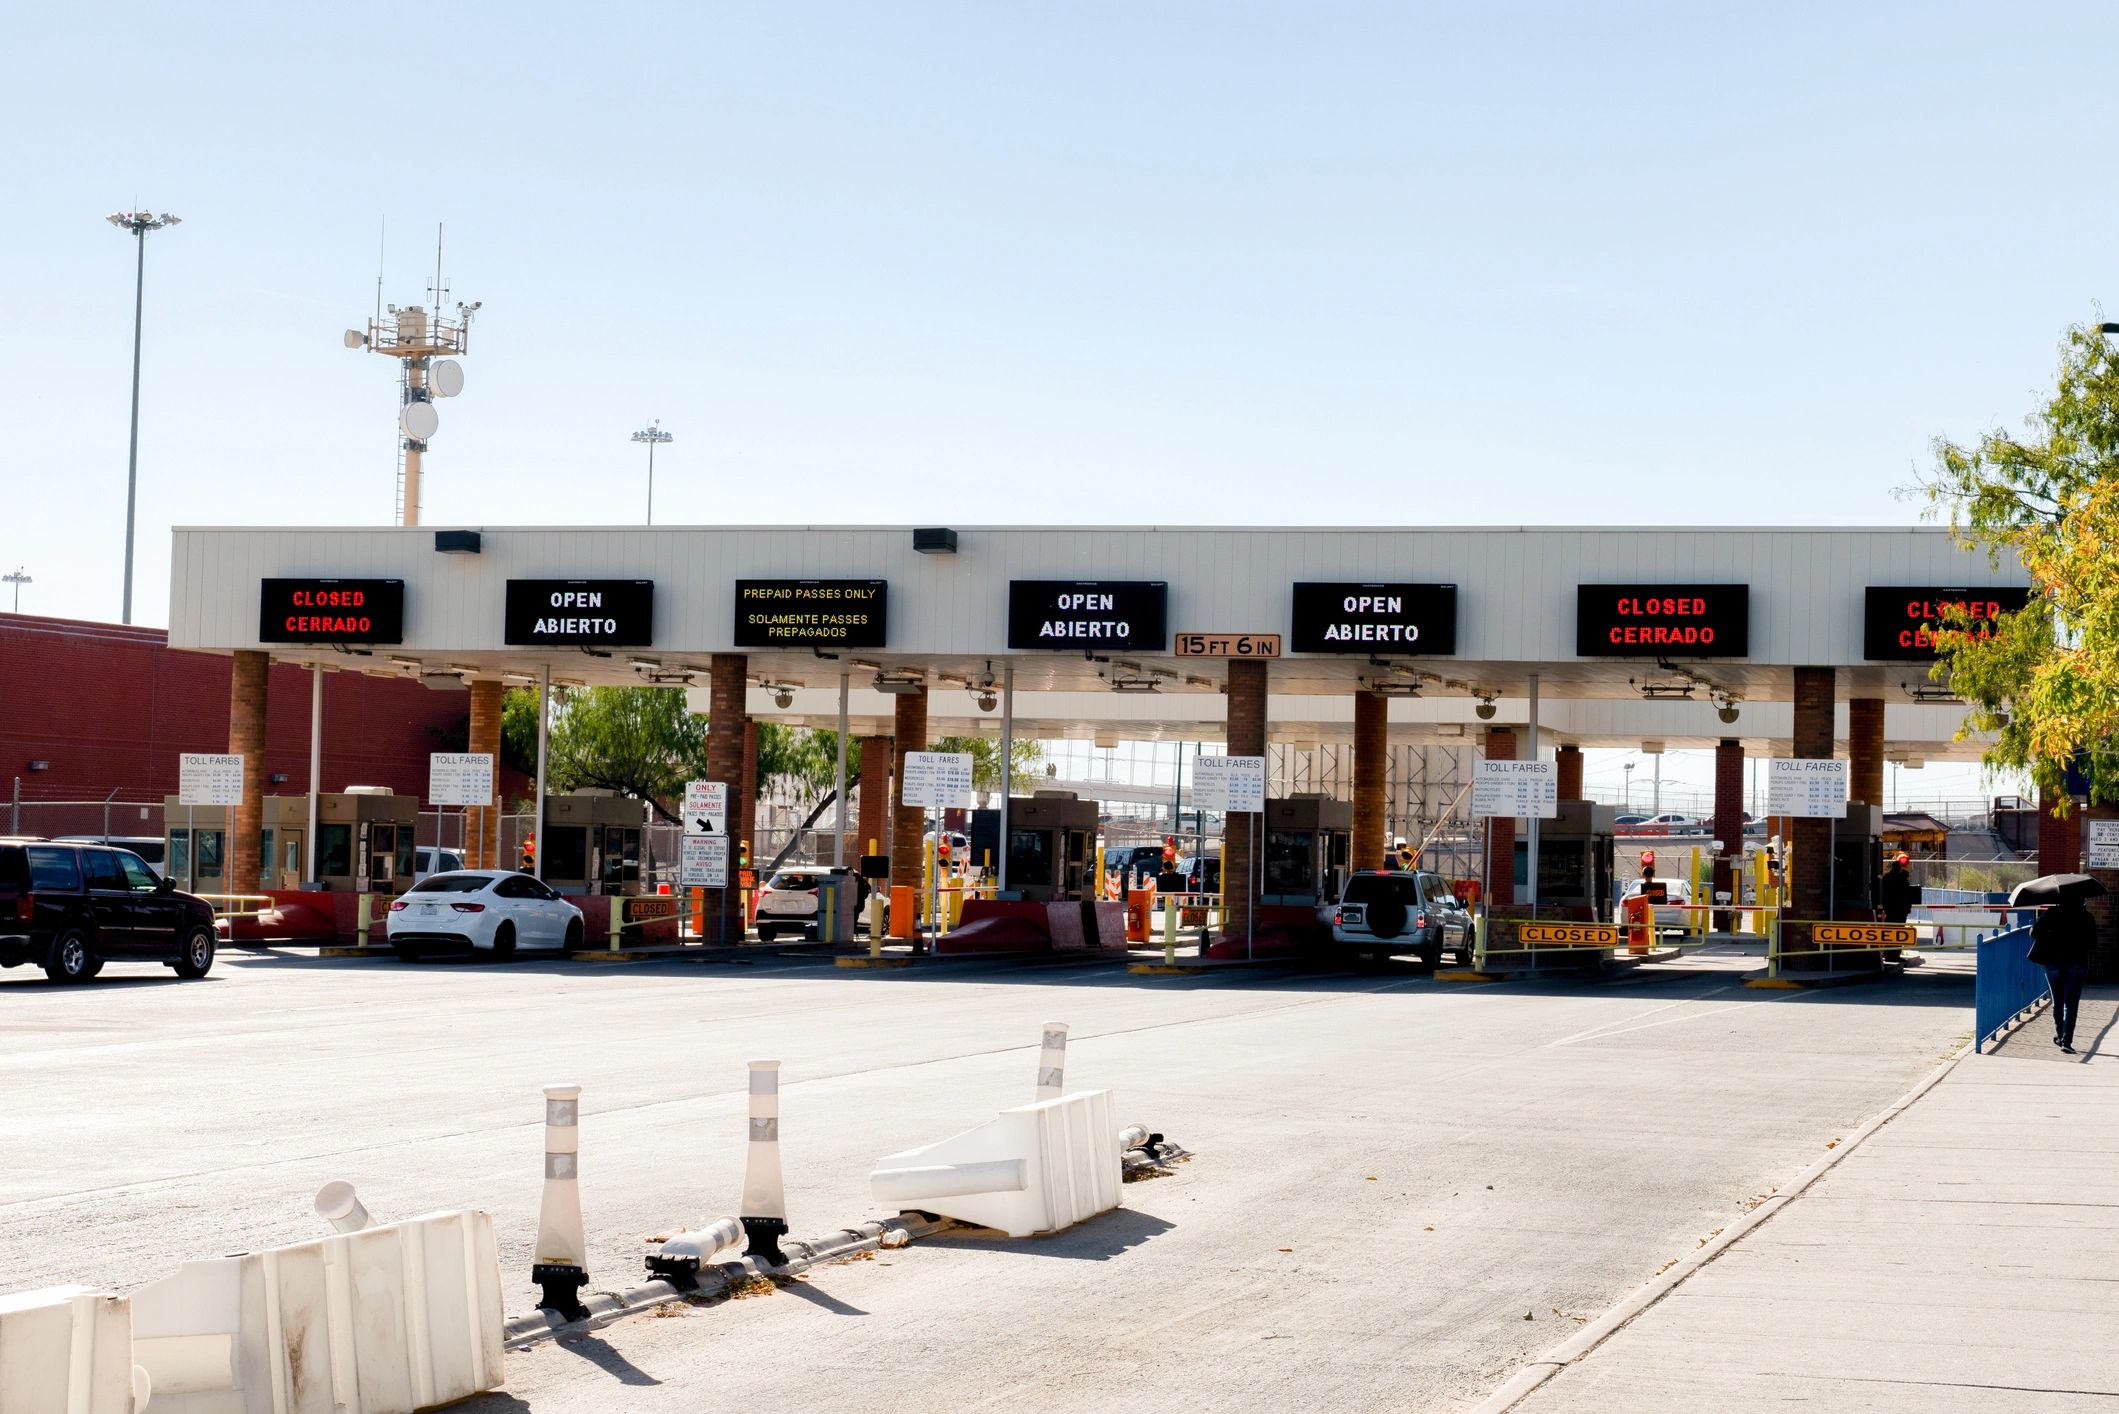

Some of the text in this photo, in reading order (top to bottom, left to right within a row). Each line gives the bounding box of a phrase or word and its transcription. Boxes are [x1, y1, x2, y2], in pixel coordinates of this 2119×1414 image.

[292, 591, 364, 606] CLOSED
[550, 592, 602, 608] OPEN
[744, 589, 876, 598] PREPAID PASSES ONLY
[1058, 594, 1114, 610] OPEN
[1344, 596, 1402, 613] OPEN
[1617, 598, 1706, 615] CLOSED
[1907, 601, 2000, 619] CLED
[286, 616, 370, 632] CERRADO
[533, 618, 616, 634] ABIERTO
[748, 614, 868, 624] SOLAMENTE PASSES
[768, 627, 847, 637] PREPAGADOS
[1039, 621, 1130, 638] ABIERTO
[1324, 624, 1418, 641] ABIERTO
[1609, 627, 1714, 644] CERRADO
[1182, 636, 1272, 654] 15 FT 6 IN
[210, 757, 240, 765] FARES
[435, 756, 489, 764] TOLL FARES
[1198, 758, 1260, 768] TOLL FARES
[1484, 763, 1548, 772] TOLL FARES
[1776, 762, 1842, 772] TOLL FARES
[632, 904, 667, 914] CLOSED
[1526, 928, 1611, 942] CLOSED
[1820, 928, 1909, 942] CLOSED
